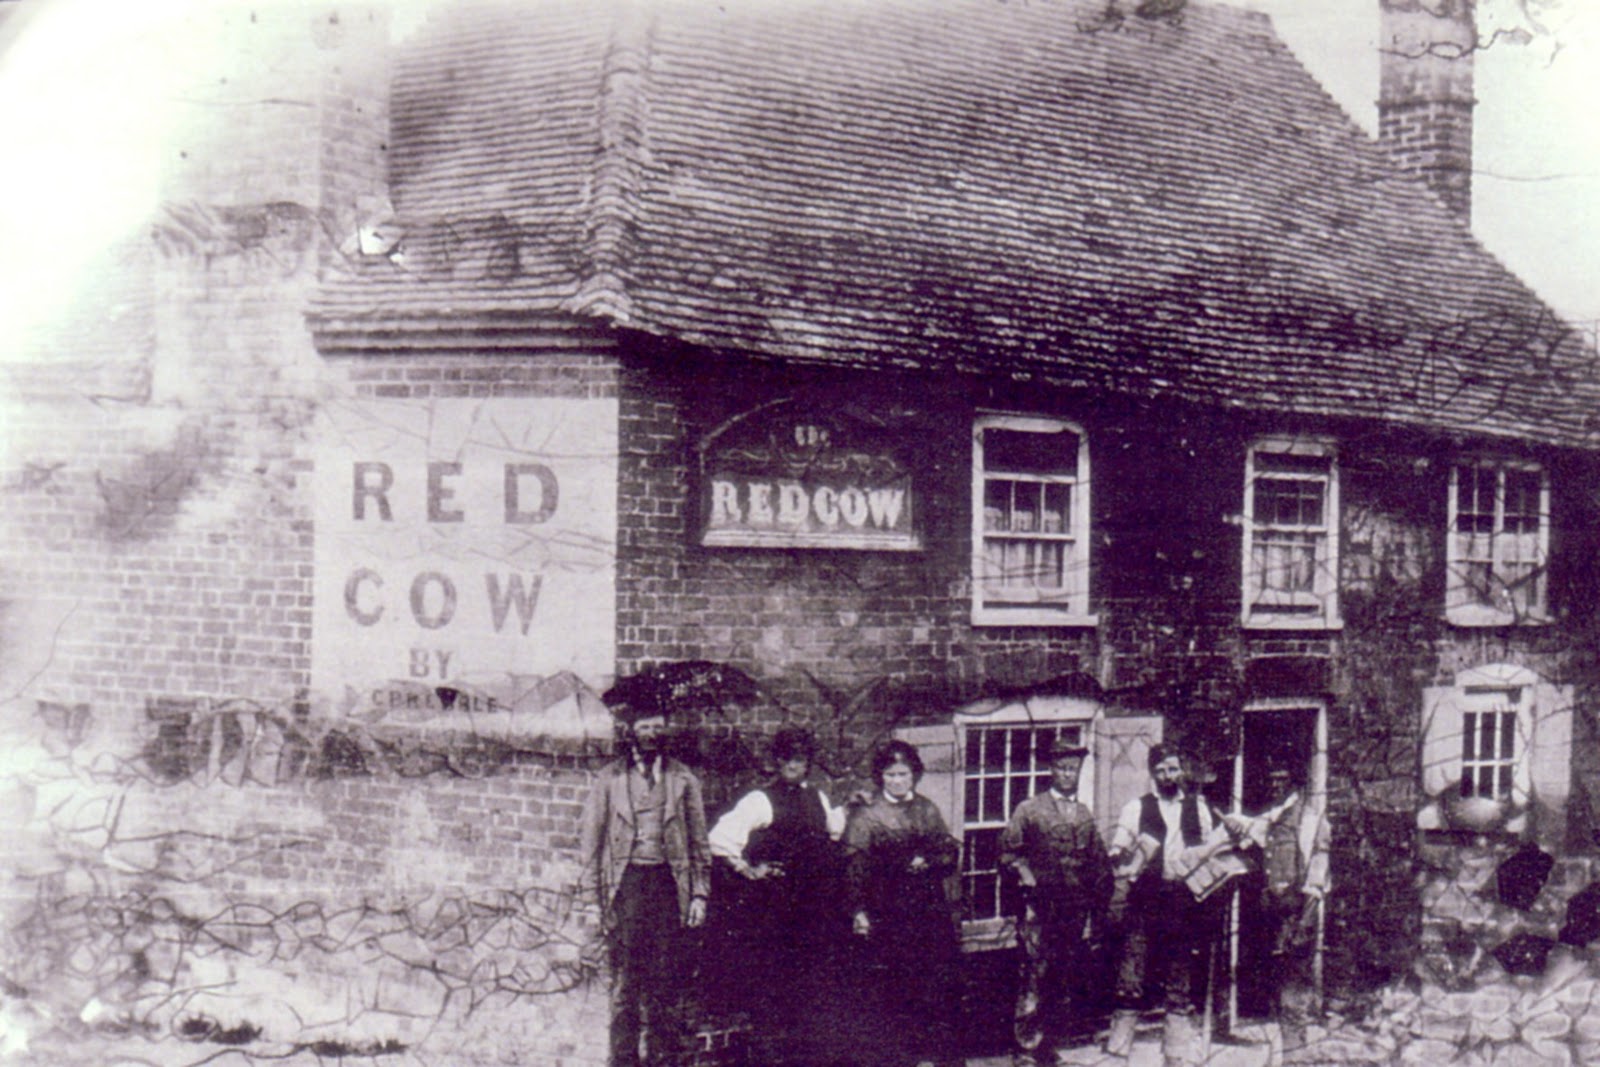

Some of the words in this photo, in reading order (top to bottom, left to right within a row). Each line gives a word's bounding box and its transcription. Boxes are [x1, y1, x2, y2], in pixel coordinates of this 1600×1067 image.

[353, 461, 559, 525] RED
[344, 567, 545, 636] COW
[409, 648, 452, 679] BY
